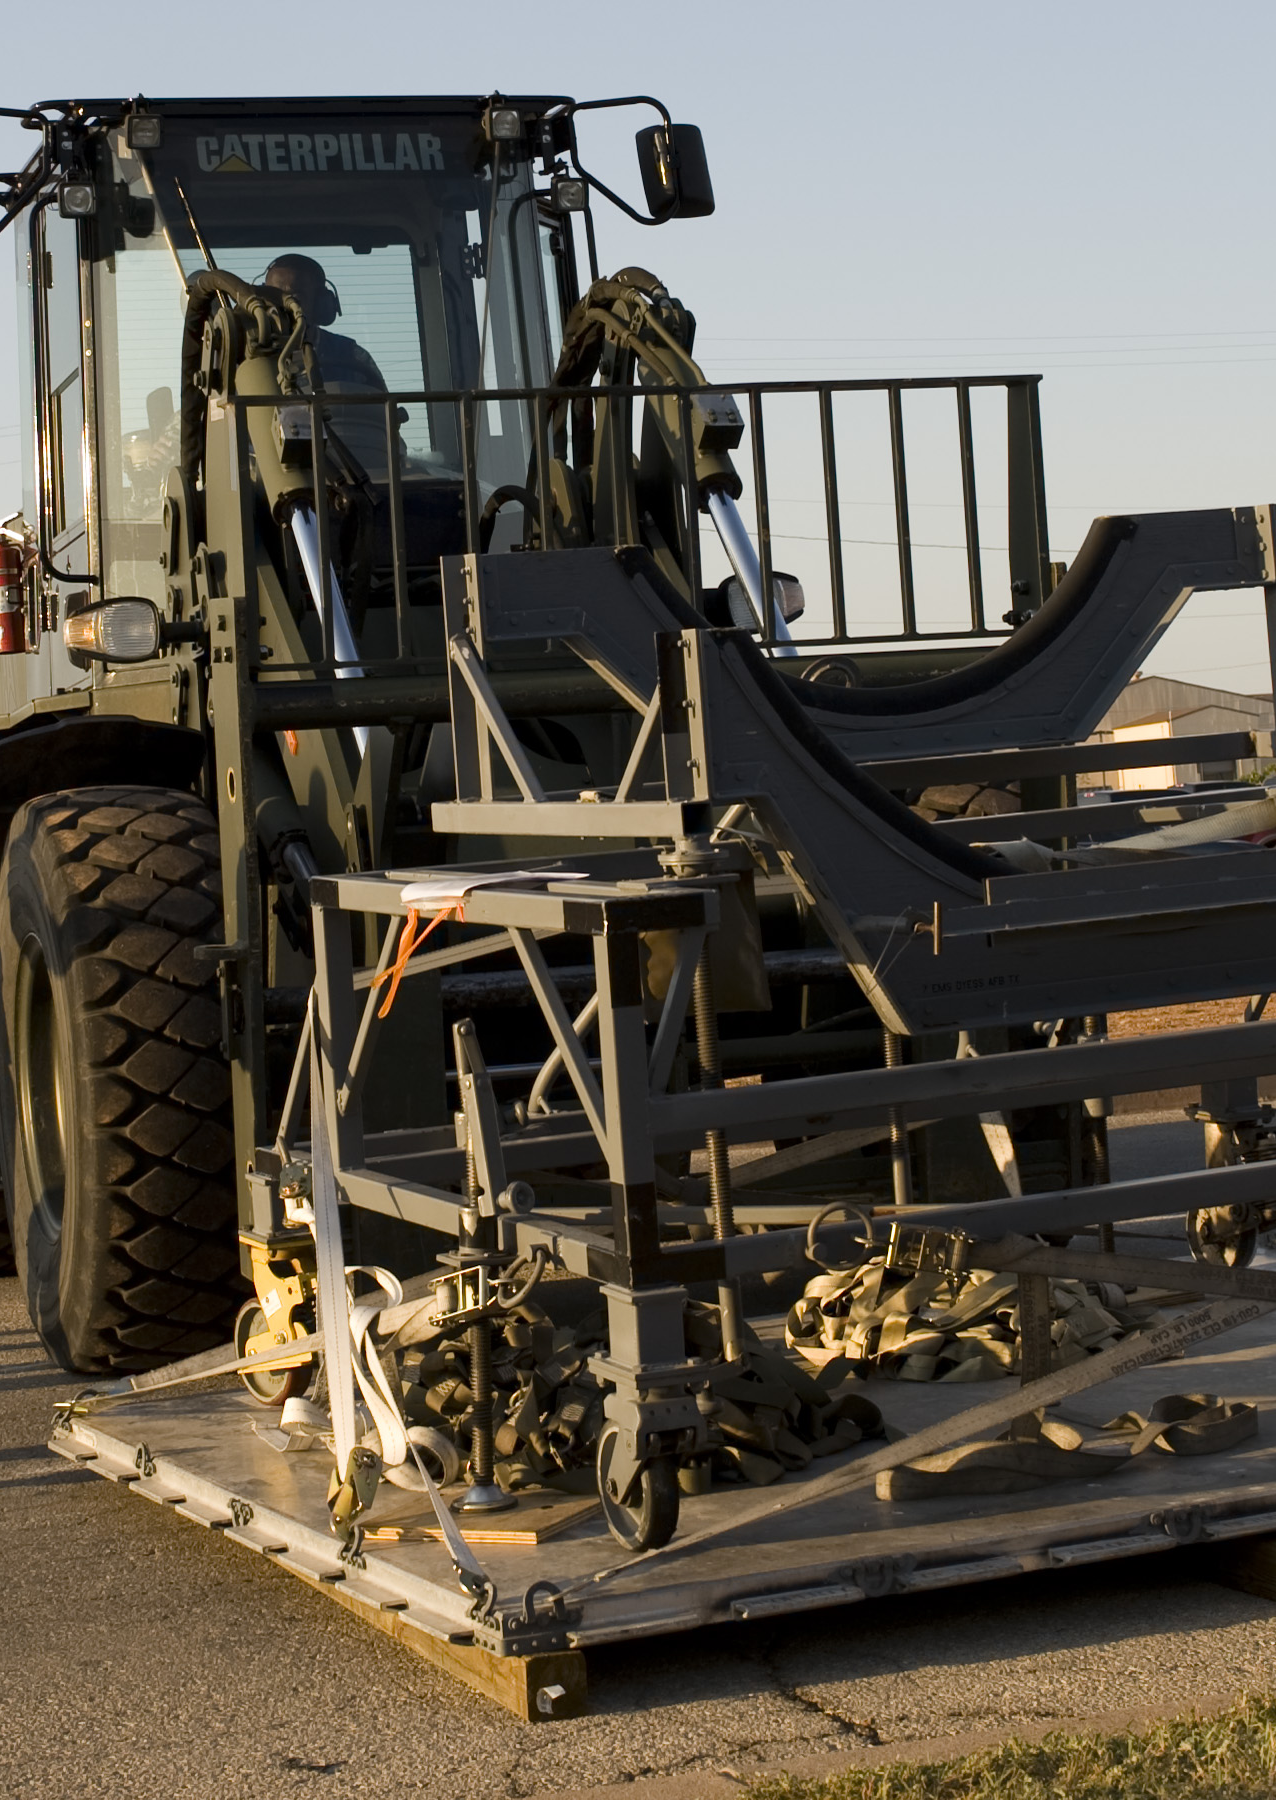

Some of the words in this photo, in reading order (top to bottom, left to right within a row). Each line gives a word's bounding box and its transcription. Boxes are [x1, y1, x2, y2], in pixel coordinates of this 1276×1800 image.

[195, 133, 445, 172] CATERPILLAR
[988, 976, 1005, 986] AFB
[1189, 1311, 1212, 1327] 5000
